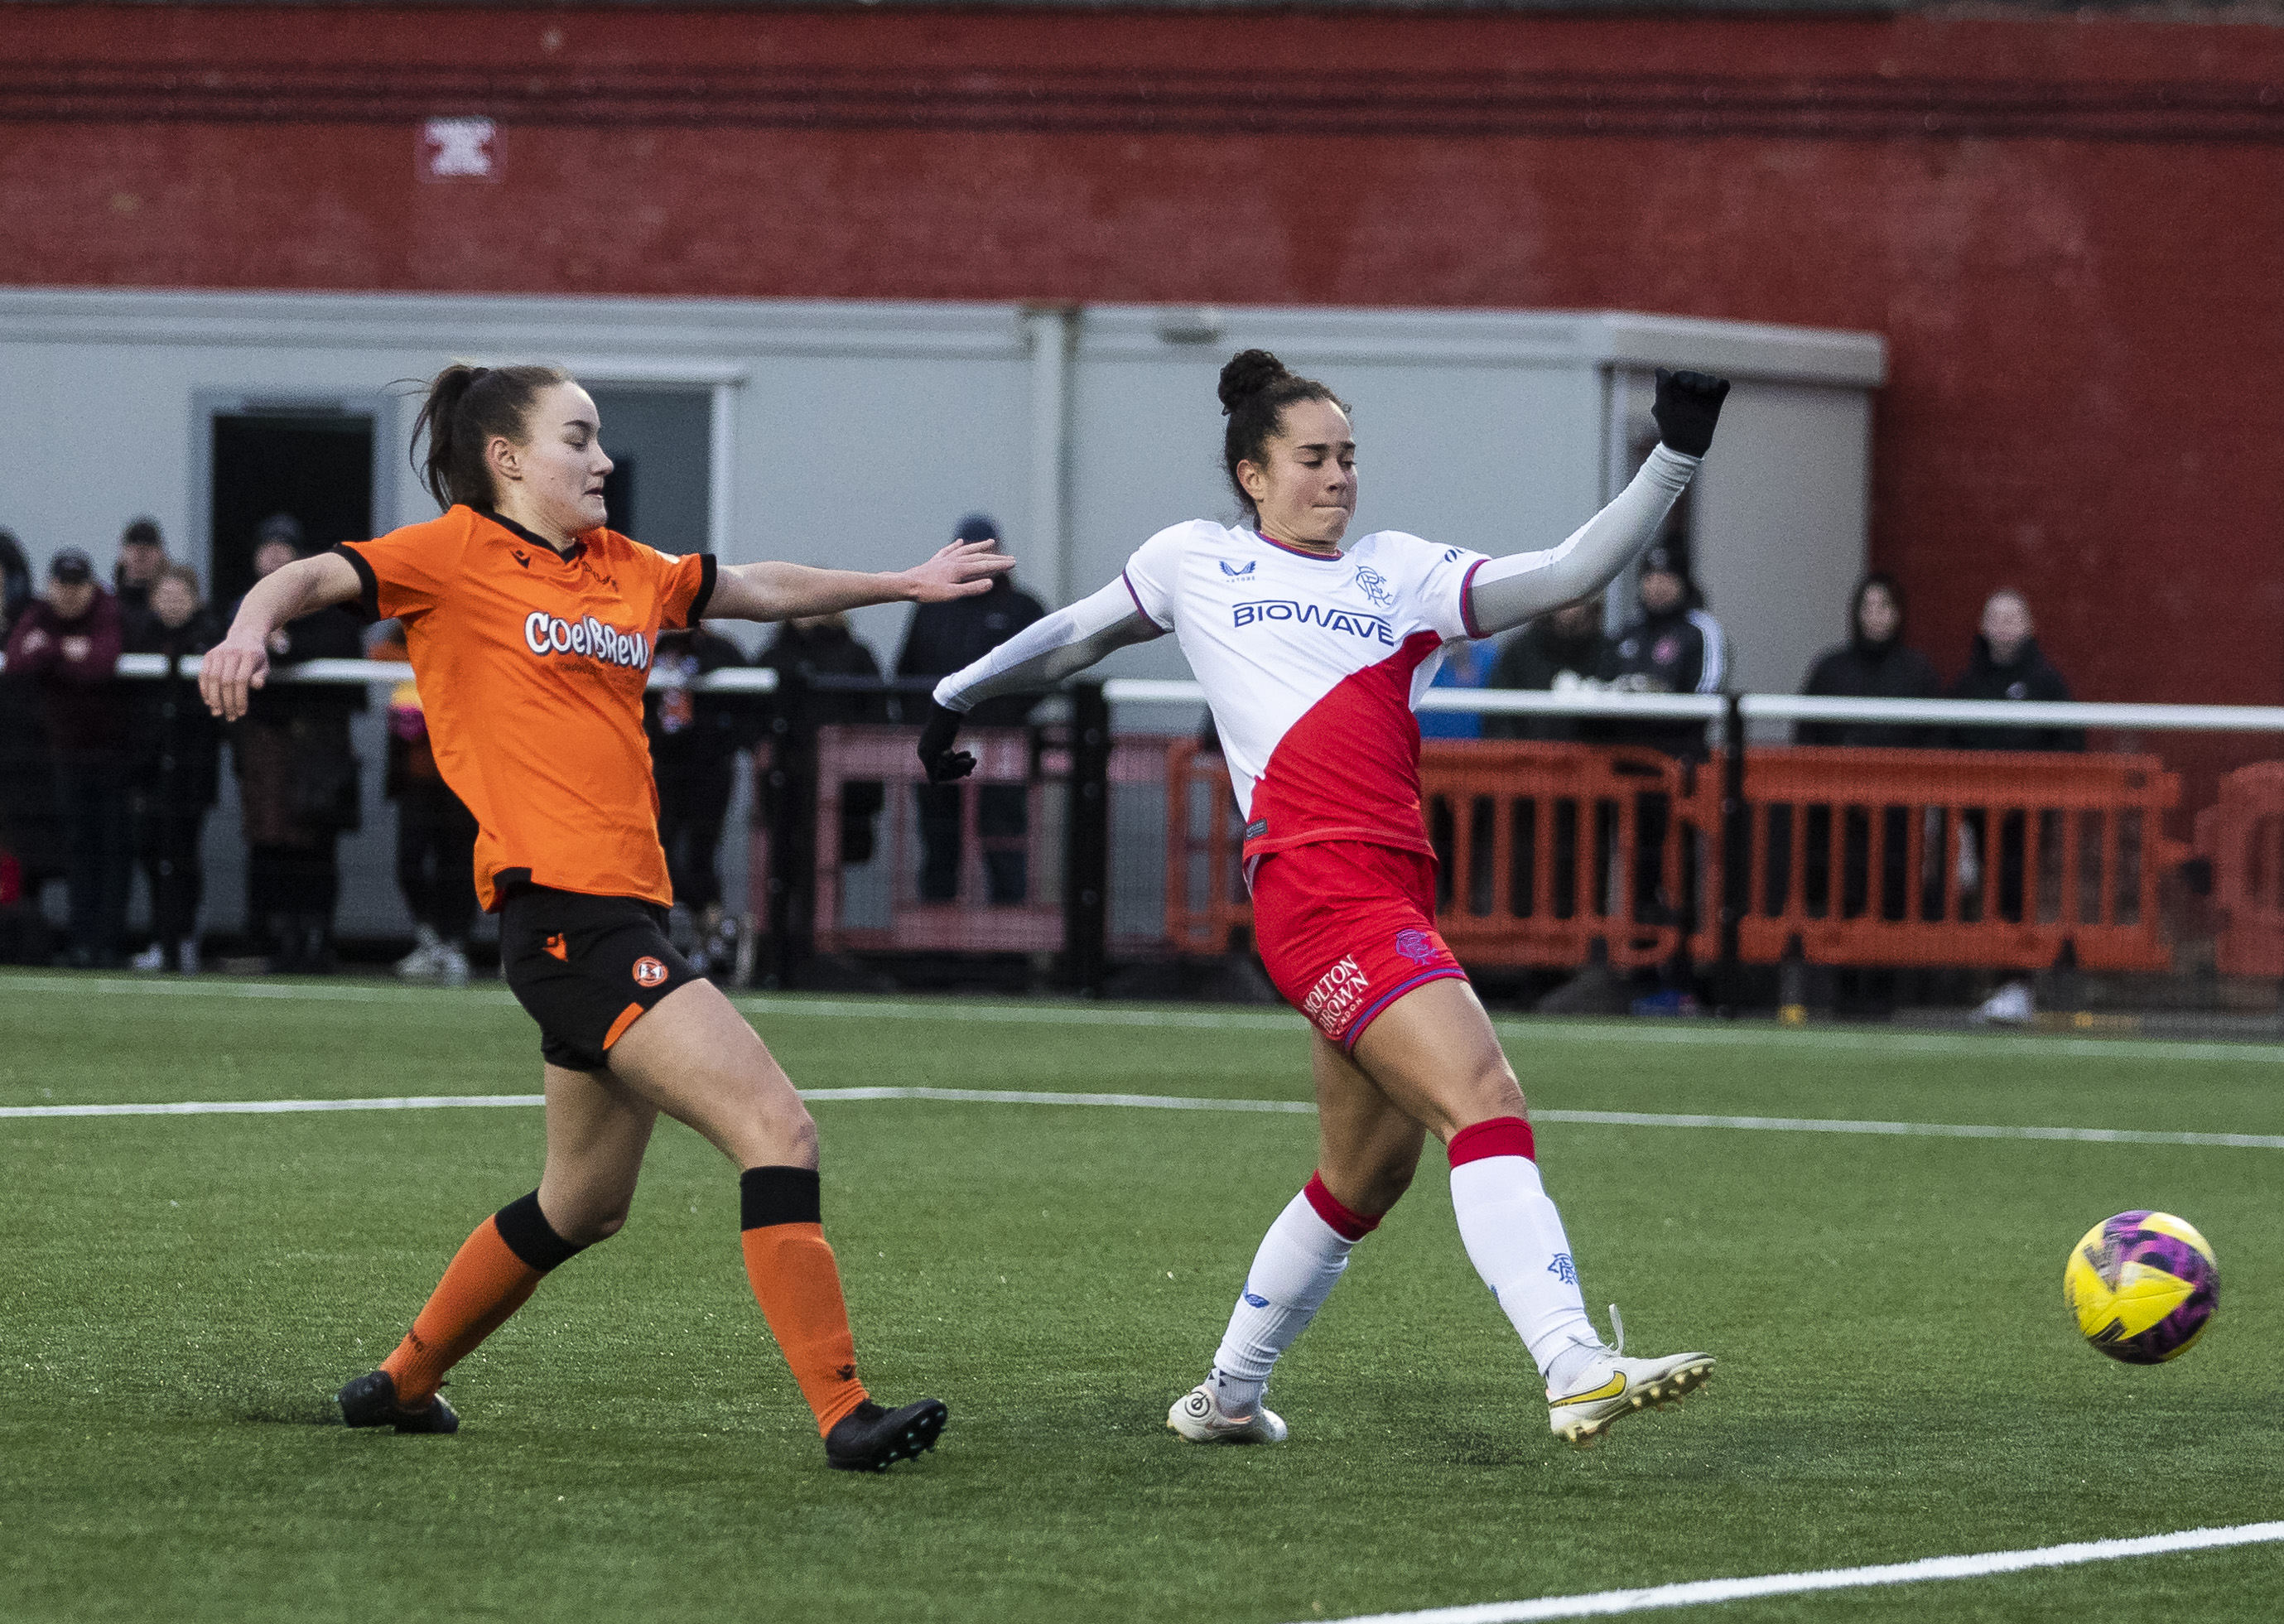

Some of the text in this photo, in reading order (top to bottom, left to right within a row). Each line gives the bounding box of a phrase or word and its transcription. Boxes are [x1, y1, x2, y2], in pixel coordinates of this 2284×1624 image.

[1232, 600, 1395, 647] BIOWAVE
[1303, 953, 1359, 1014] MOLTON
[1319, 971, 1370, 1034] BROWN
